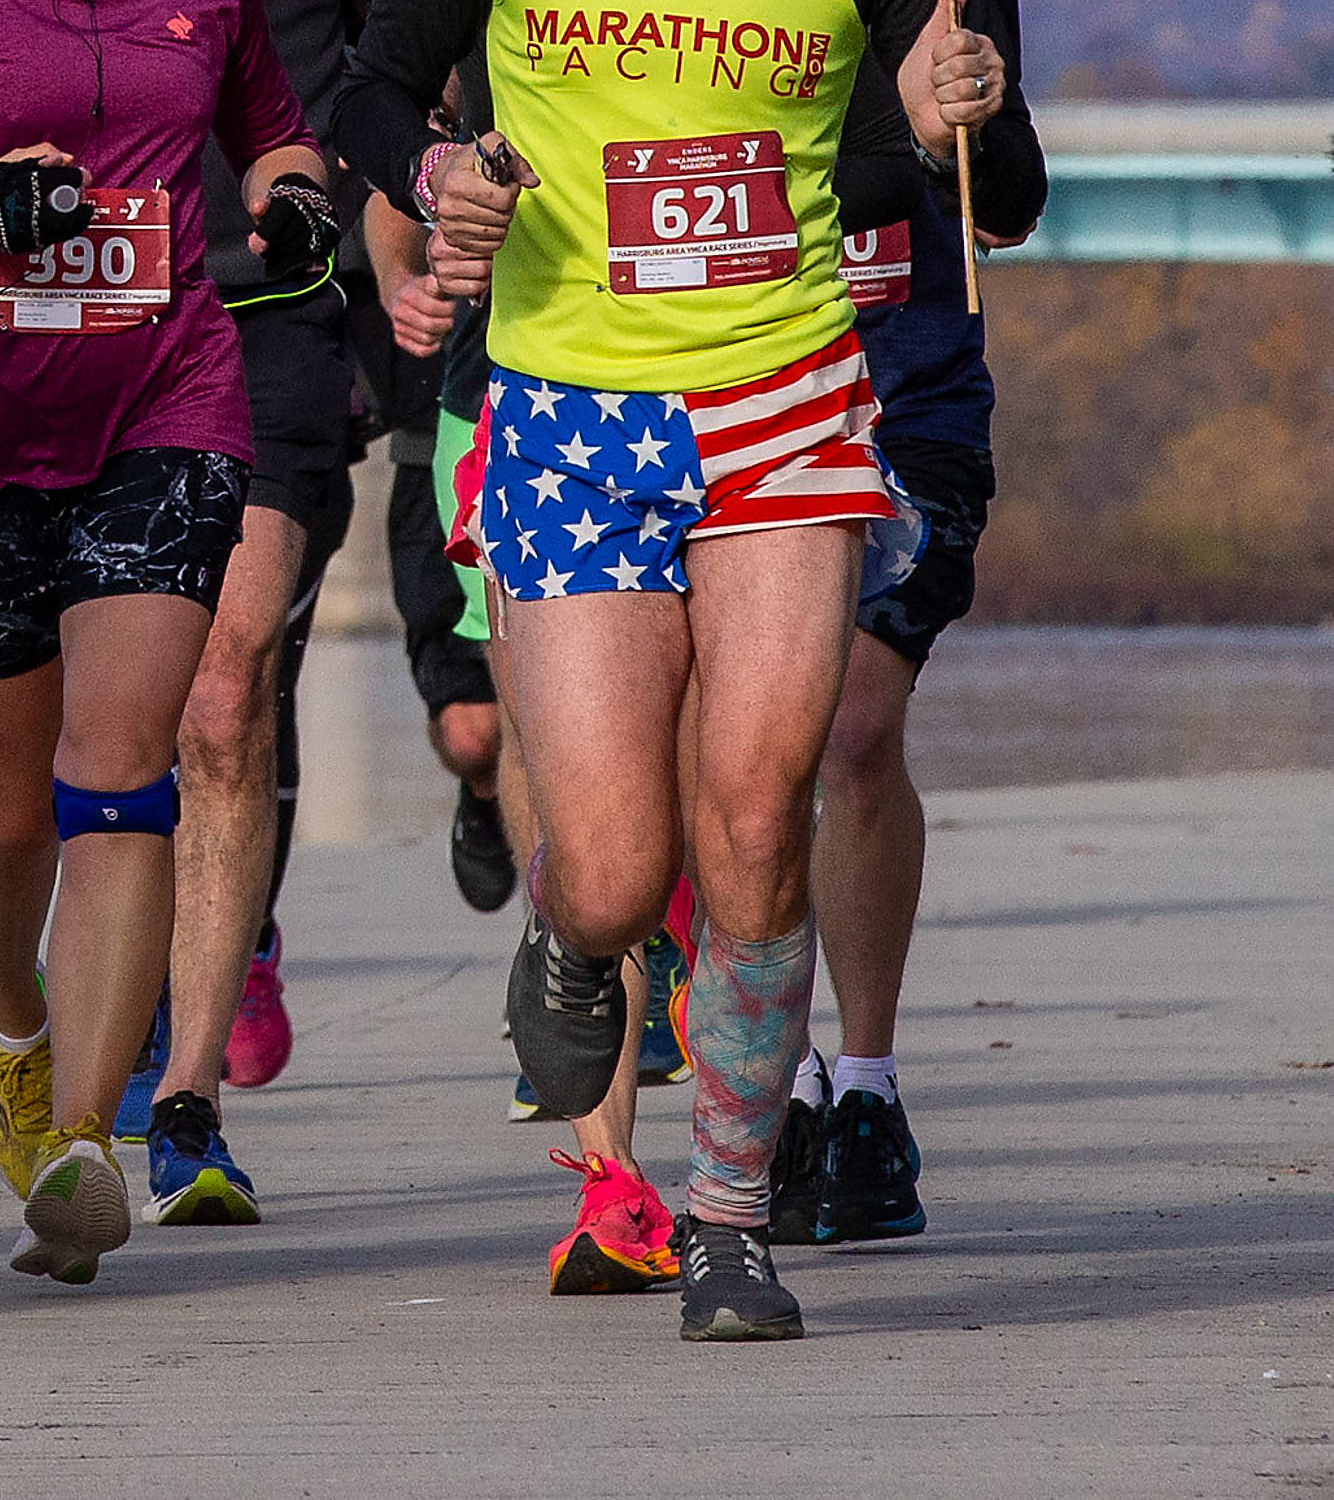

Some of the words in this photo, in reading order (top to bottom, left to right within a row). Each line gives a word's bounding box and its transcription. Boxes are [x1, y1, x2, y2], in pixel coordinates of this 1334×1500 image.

[524, 8, 803, 64] MARATHON
[526, 43, 798, 97] PACING
[651, 182, 750, 240] 621
[24, 236, 136, 284] 390
[666, 246, 686, 255] AREA
[709, 243, 727, 252] RACE
